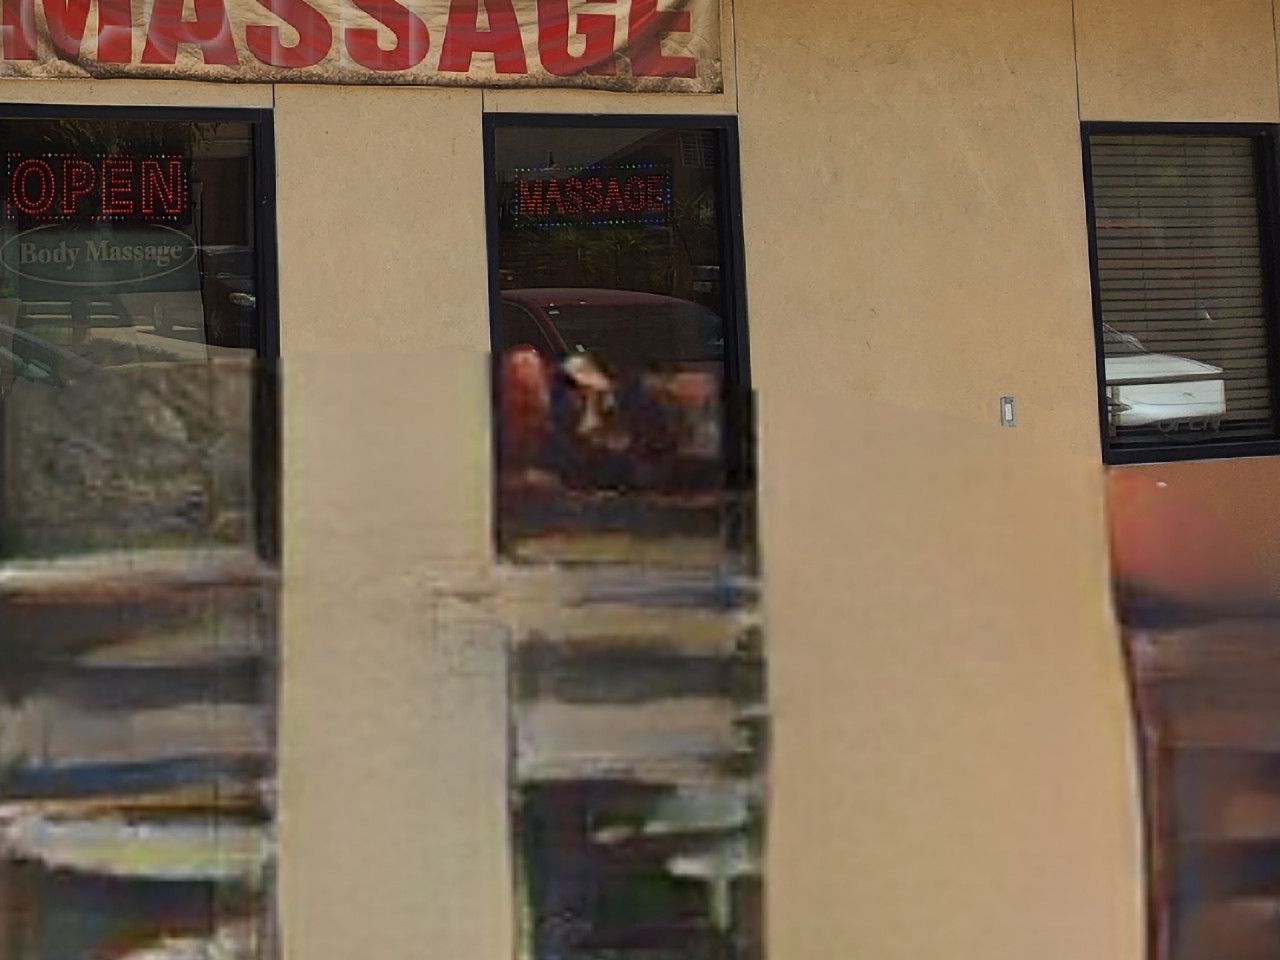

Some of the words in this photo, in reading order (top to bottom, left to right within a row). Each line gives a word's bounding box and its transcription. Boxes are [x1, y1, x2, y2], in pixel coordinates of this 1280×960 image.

[12, 158, 183, 214] OPEN
[519, 175, 665, 215] MASSAGE
[20, 241, 80, 270] Body
[85, 240, 183, 267] Massage
